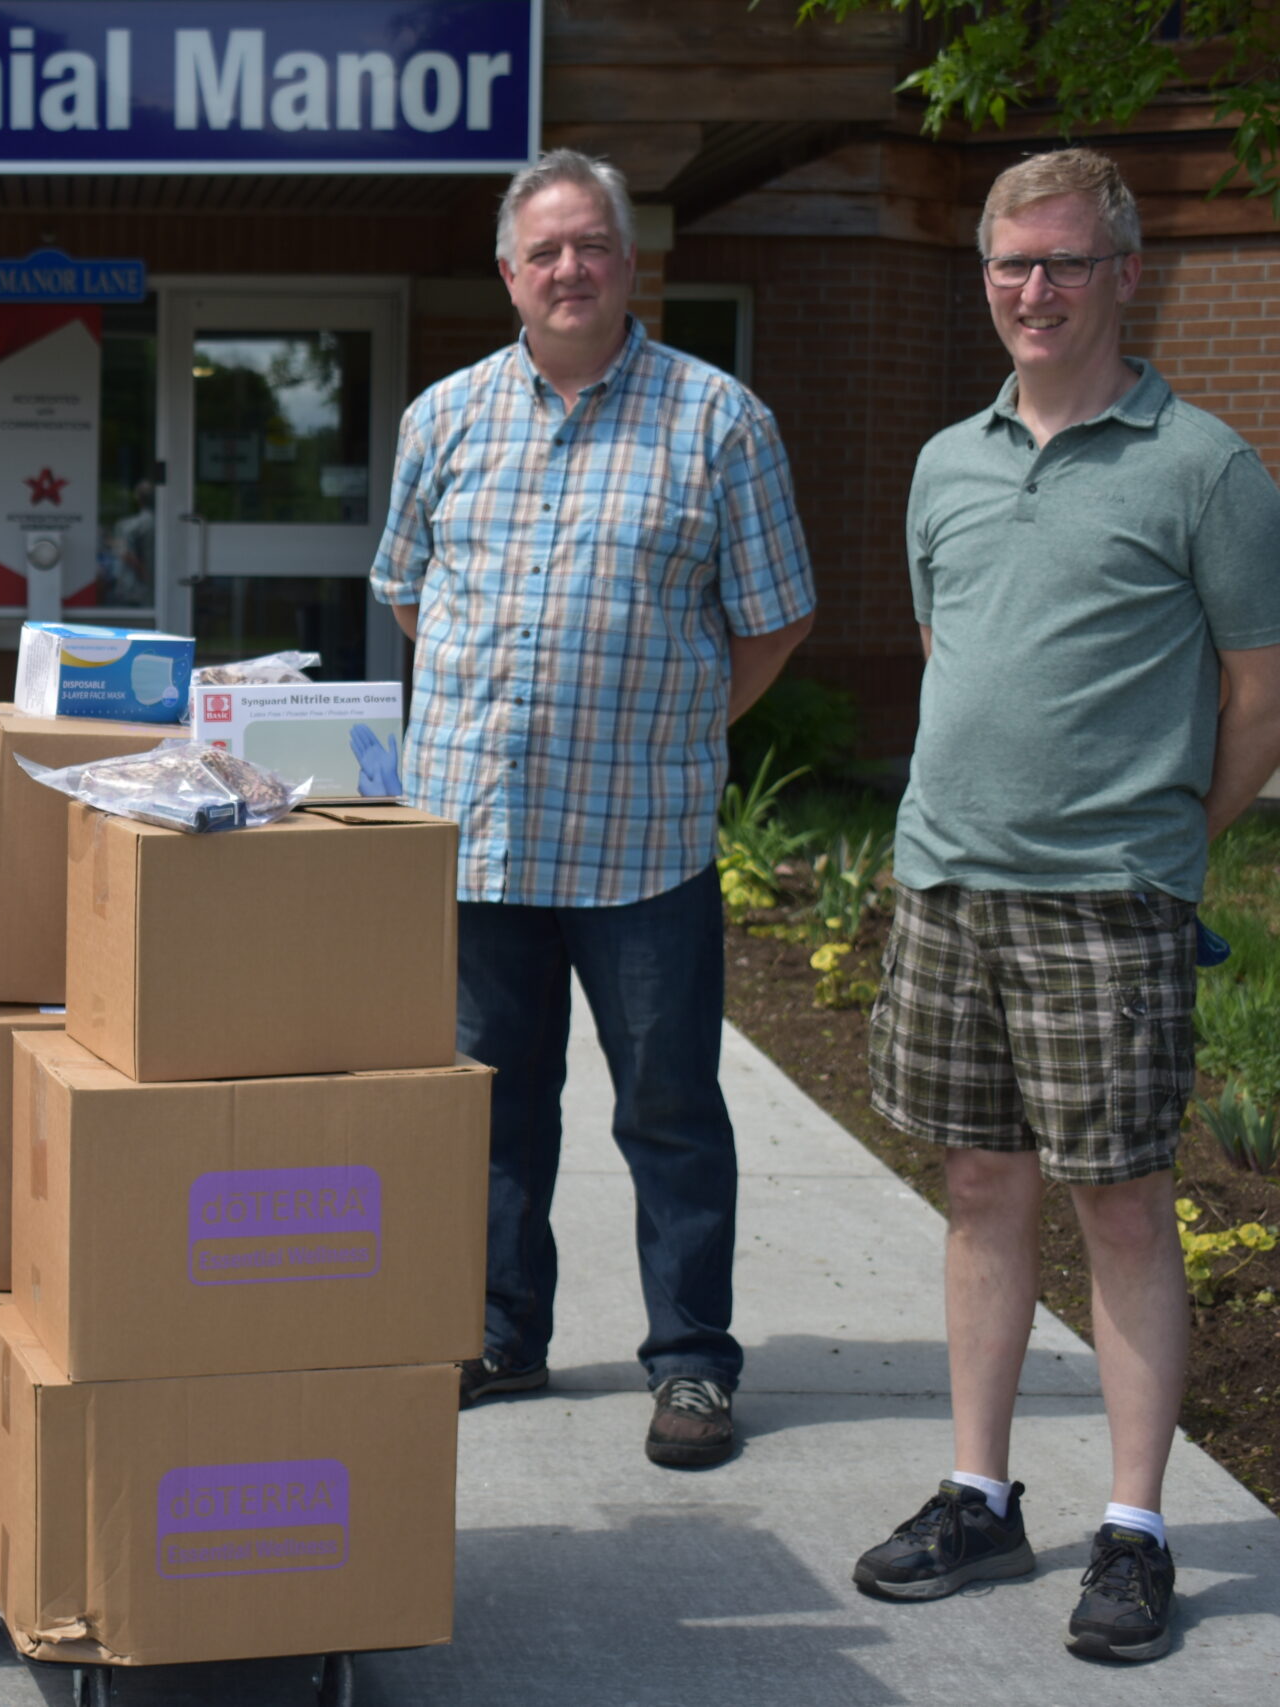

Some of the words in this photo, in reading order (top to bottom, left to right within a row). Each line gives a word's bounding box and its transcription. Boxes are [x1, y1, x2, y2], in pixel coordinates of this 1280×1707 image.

[174, 28, 512, 132] Manor
[83, 269, 138, 294] LANE
[62, 680, 106, 690] DISPOSABLE
[89, 691, 106, 700] FACE
[107, 691, 126, 700] MASK
[241, 697, 287, 707] Synguard
[289, 694, 330, 705] Nitrile
[333, 695, 361, 704] Exam
[363, 694, 397, 704] Gloves
[199, 1247, 283, 1271] Essential
[287, 1245, 370, 1266] Wellness
[167, 1541, 253, 1564] Essential
[256, 1538, 338, 1559] Wellness
